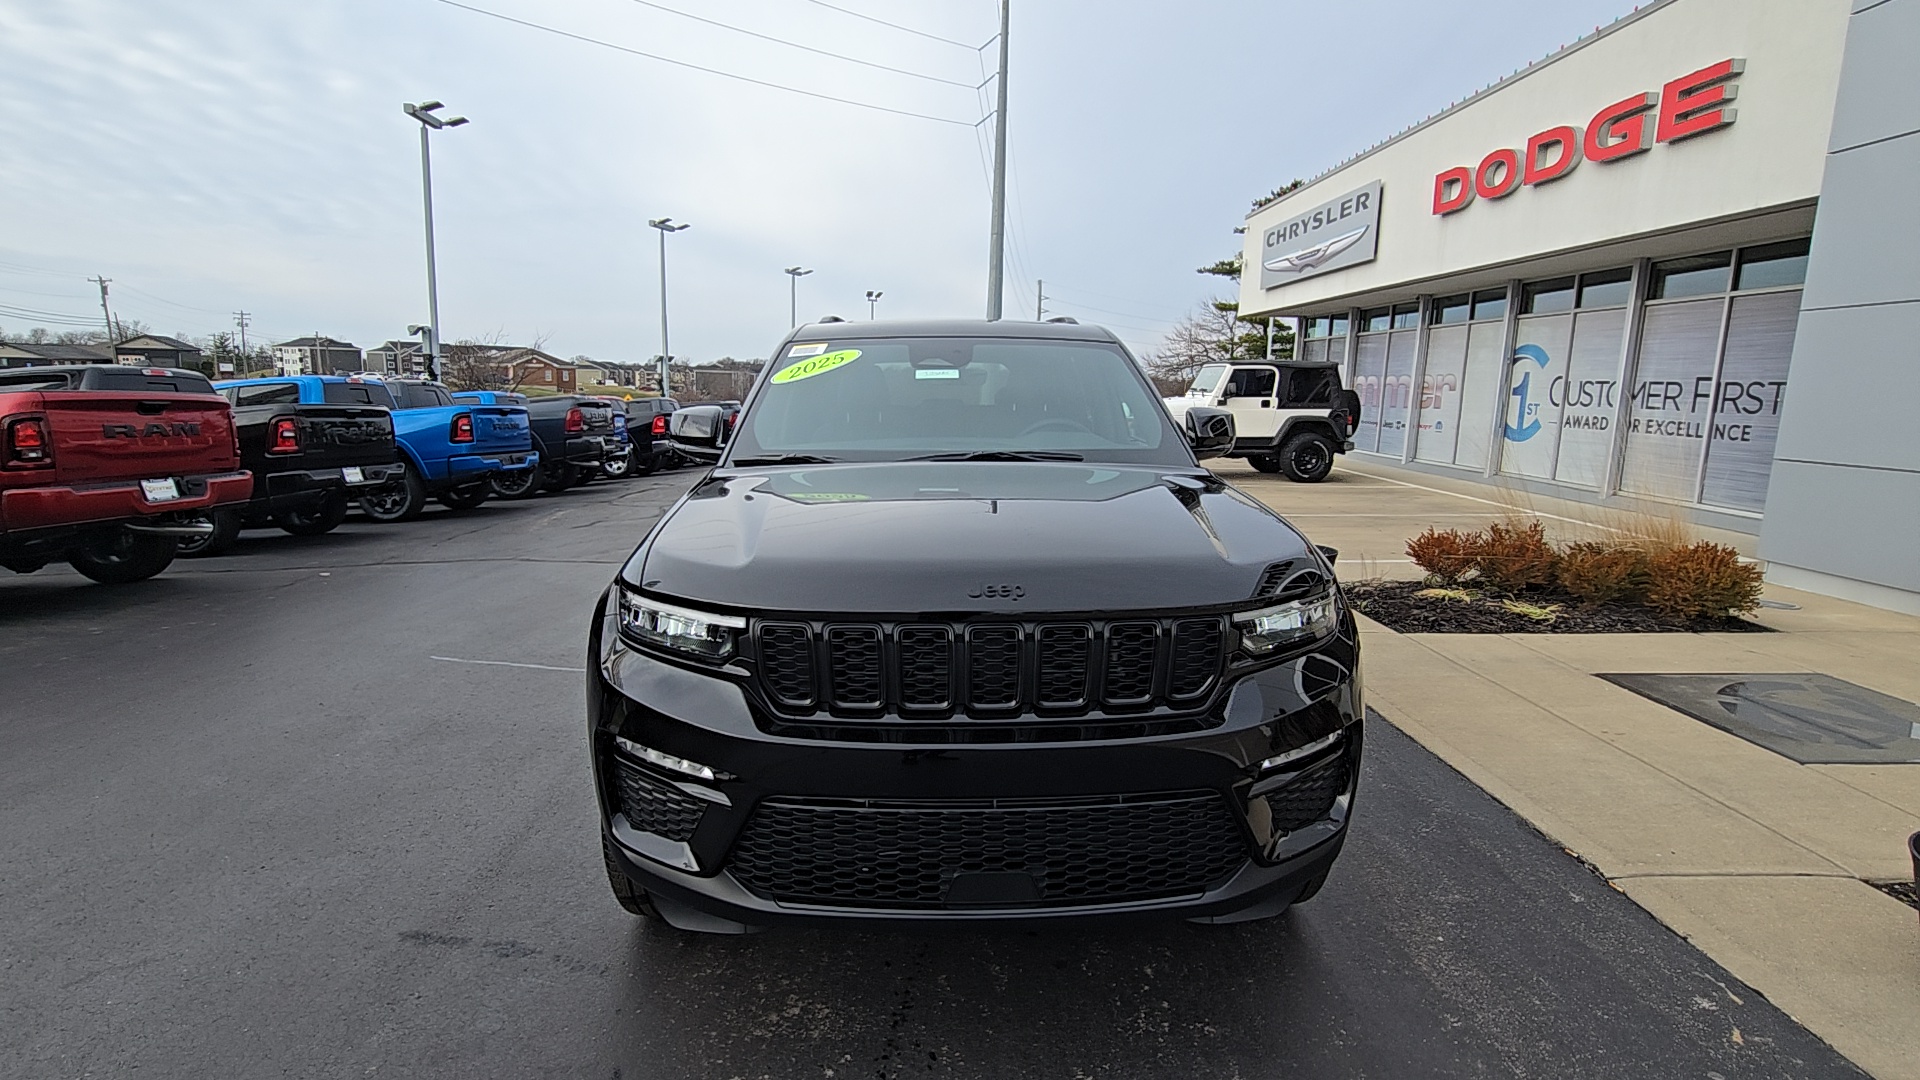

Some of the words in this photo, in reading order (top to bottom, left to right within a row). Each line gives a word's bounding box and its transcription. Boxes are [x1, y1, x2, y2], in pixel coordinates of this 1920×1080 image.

[1432, 58, 1746, 215] DODGE
[1266, 191, 1370, 248] CHRYSLER
[789, 353, 844, 379] 2025
[102, 422, 200, 438] RAM
[1563, 415, 1609, 430] AWARD
[1645, 419, 1753, 441] EXCELLNCE
[967, 583, 1026, 602] Jeep
